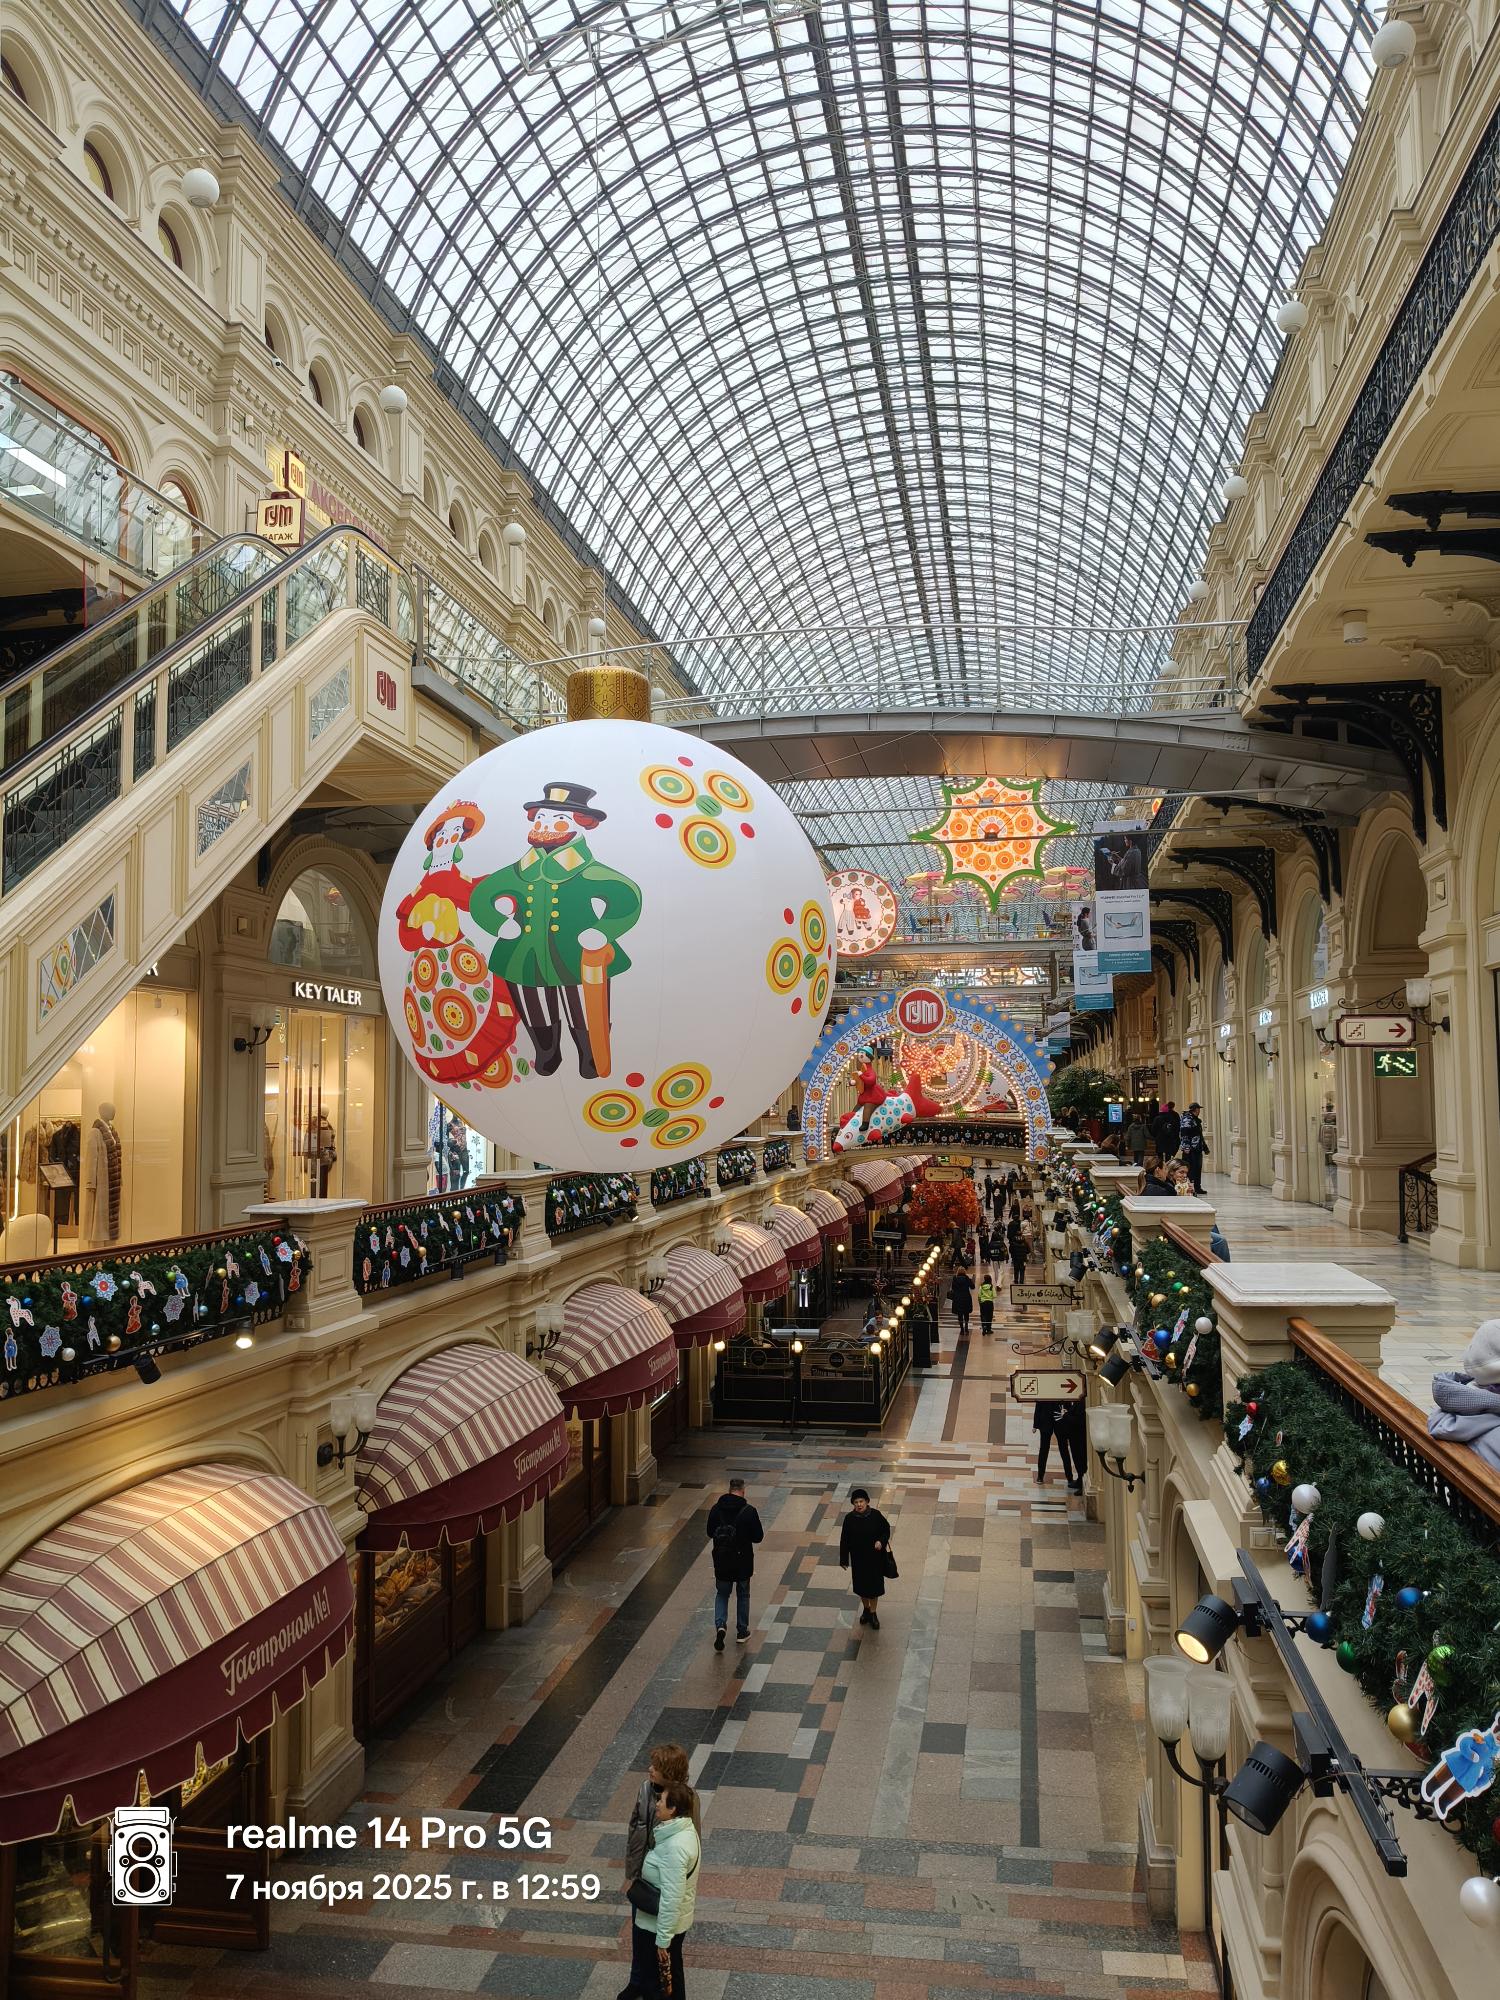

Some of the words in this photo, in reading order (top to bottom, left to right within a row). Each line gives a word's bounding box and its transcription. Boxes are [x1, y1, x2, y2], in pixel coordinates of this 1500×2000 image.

[295, 981, 322, 1000] KEY
[325, 985, 362, 1006] TALER
[513, 1437, 555, 1481] Гастроном
[220, 1607, 316, 1697] Гастроном
[312, 1585, 331, 1625] №1
